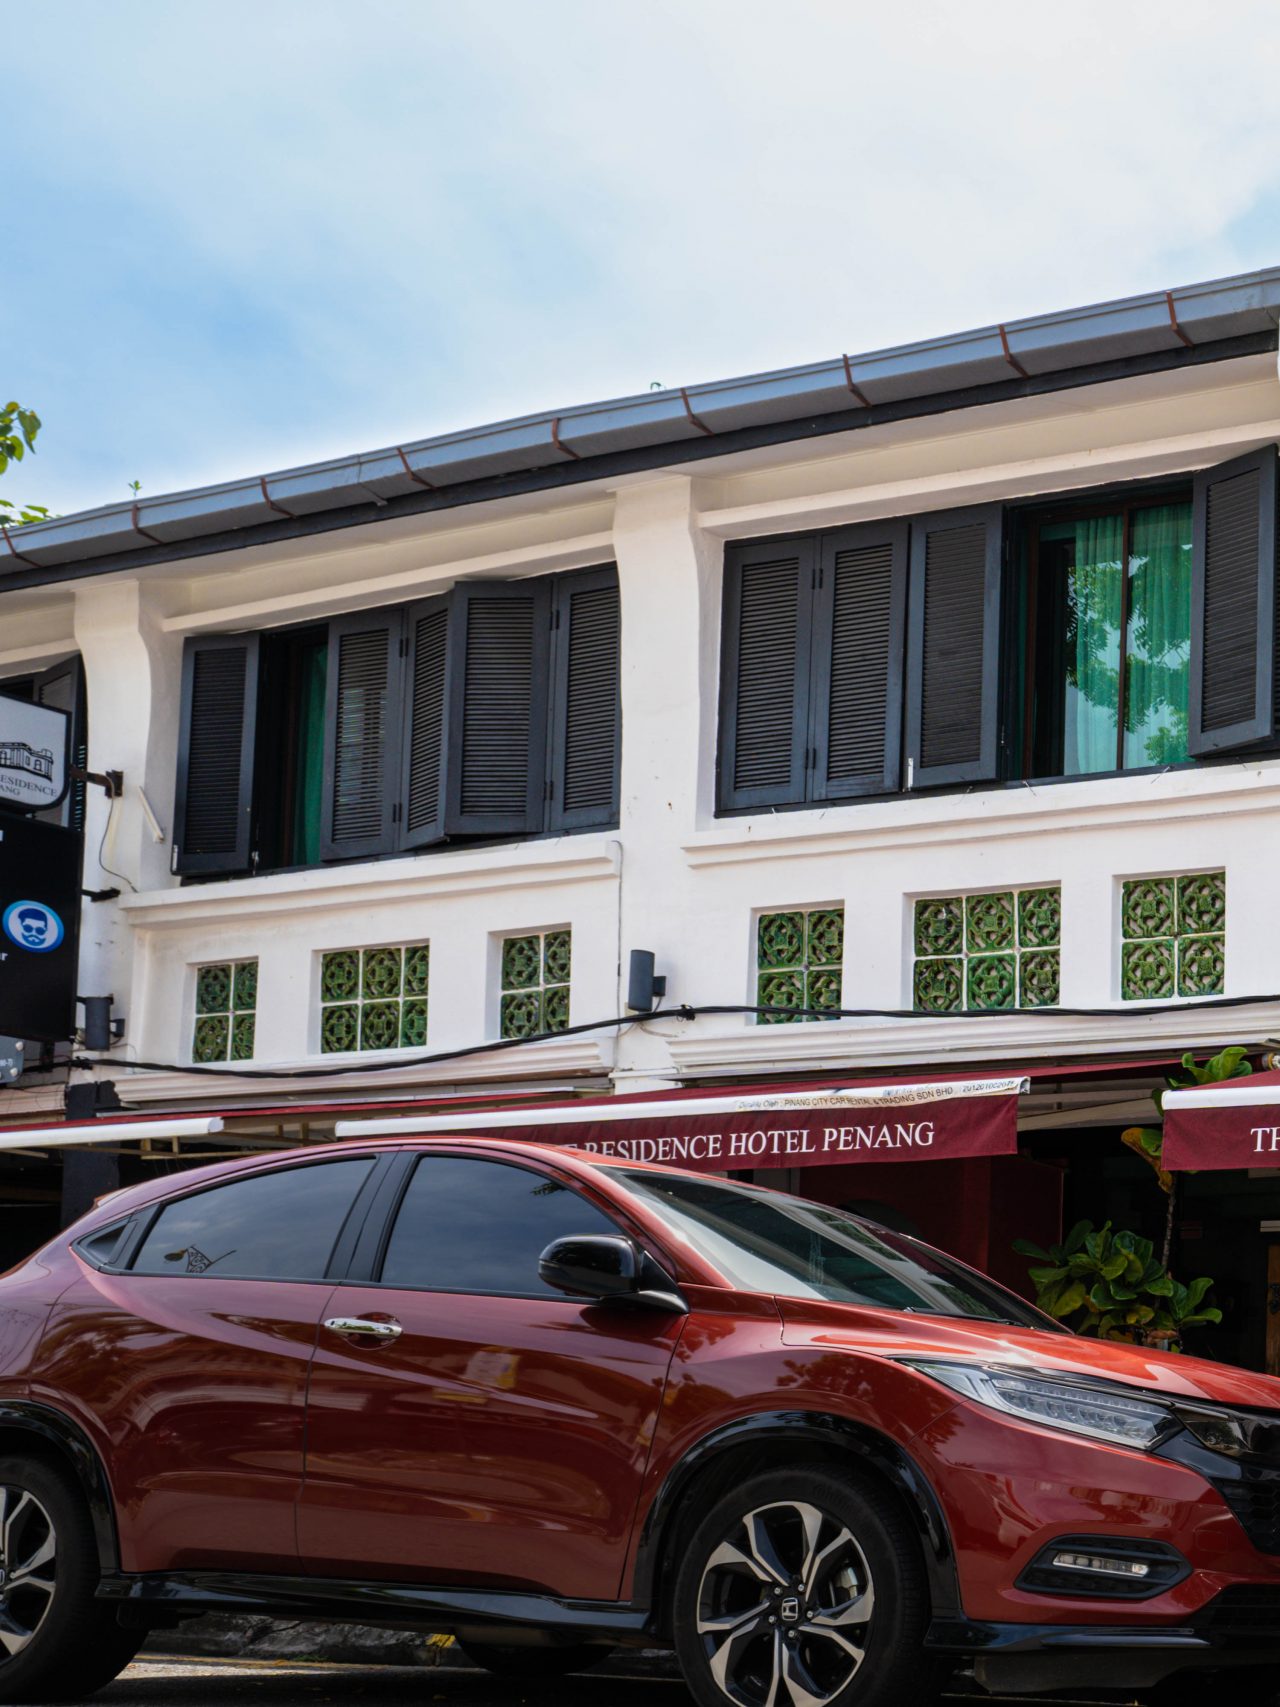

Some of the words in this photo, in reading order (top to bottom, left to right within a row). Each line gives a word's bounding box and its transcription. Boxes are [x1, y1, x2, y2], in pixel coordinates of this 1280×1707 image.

[0, 774, 58, 797] ESIDENCE
[879, 1093, 916, 1105] TRADING
[916, 1090, 935, 1100] SDN
[935, 1086, 954, 1097] BHD
[728, 1129, 817, 1156] HOTEL
[821, 1121, 935, 1152] PENANG
